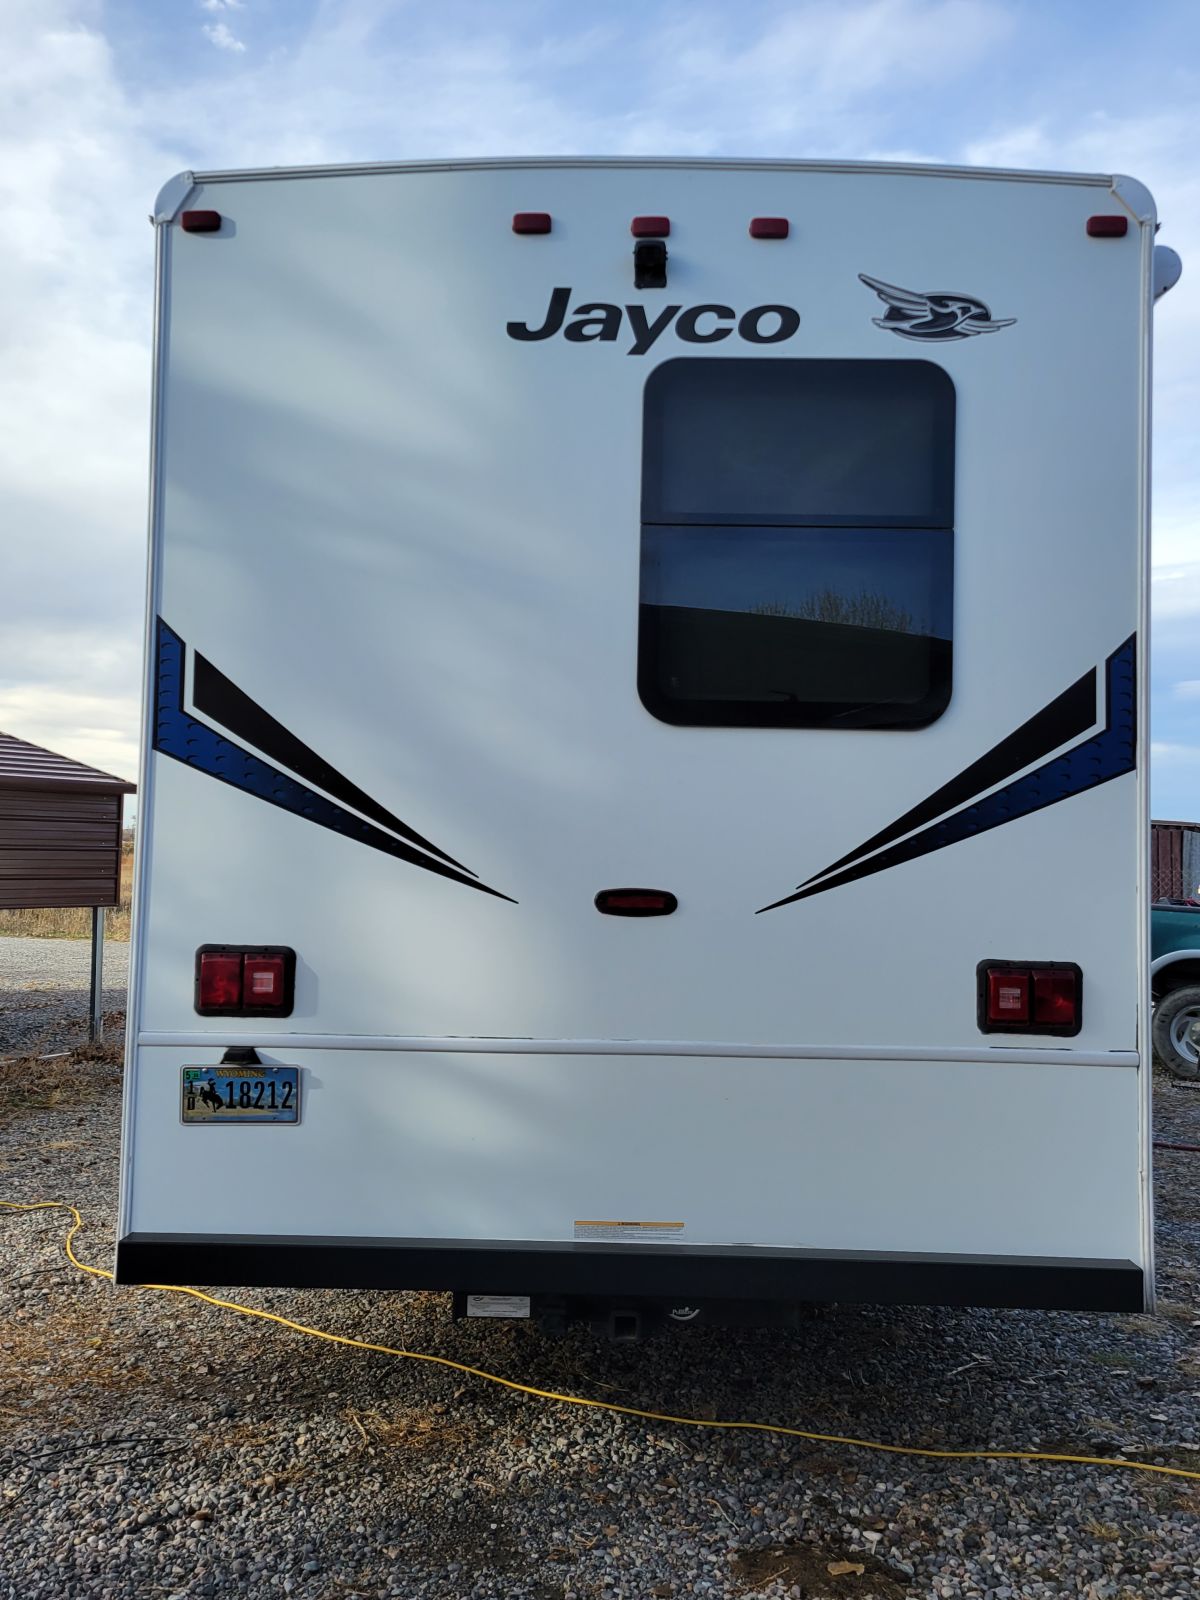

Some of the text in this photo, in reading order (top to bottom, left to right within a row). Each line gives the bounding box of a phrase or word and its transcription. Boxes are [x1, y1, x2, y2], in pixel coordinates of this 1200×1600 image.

[506, 287, 801, 356] Jayco
[215, 1069, 266, 1078] WYOMING
[225, 1081, 293, 1109] 18212
